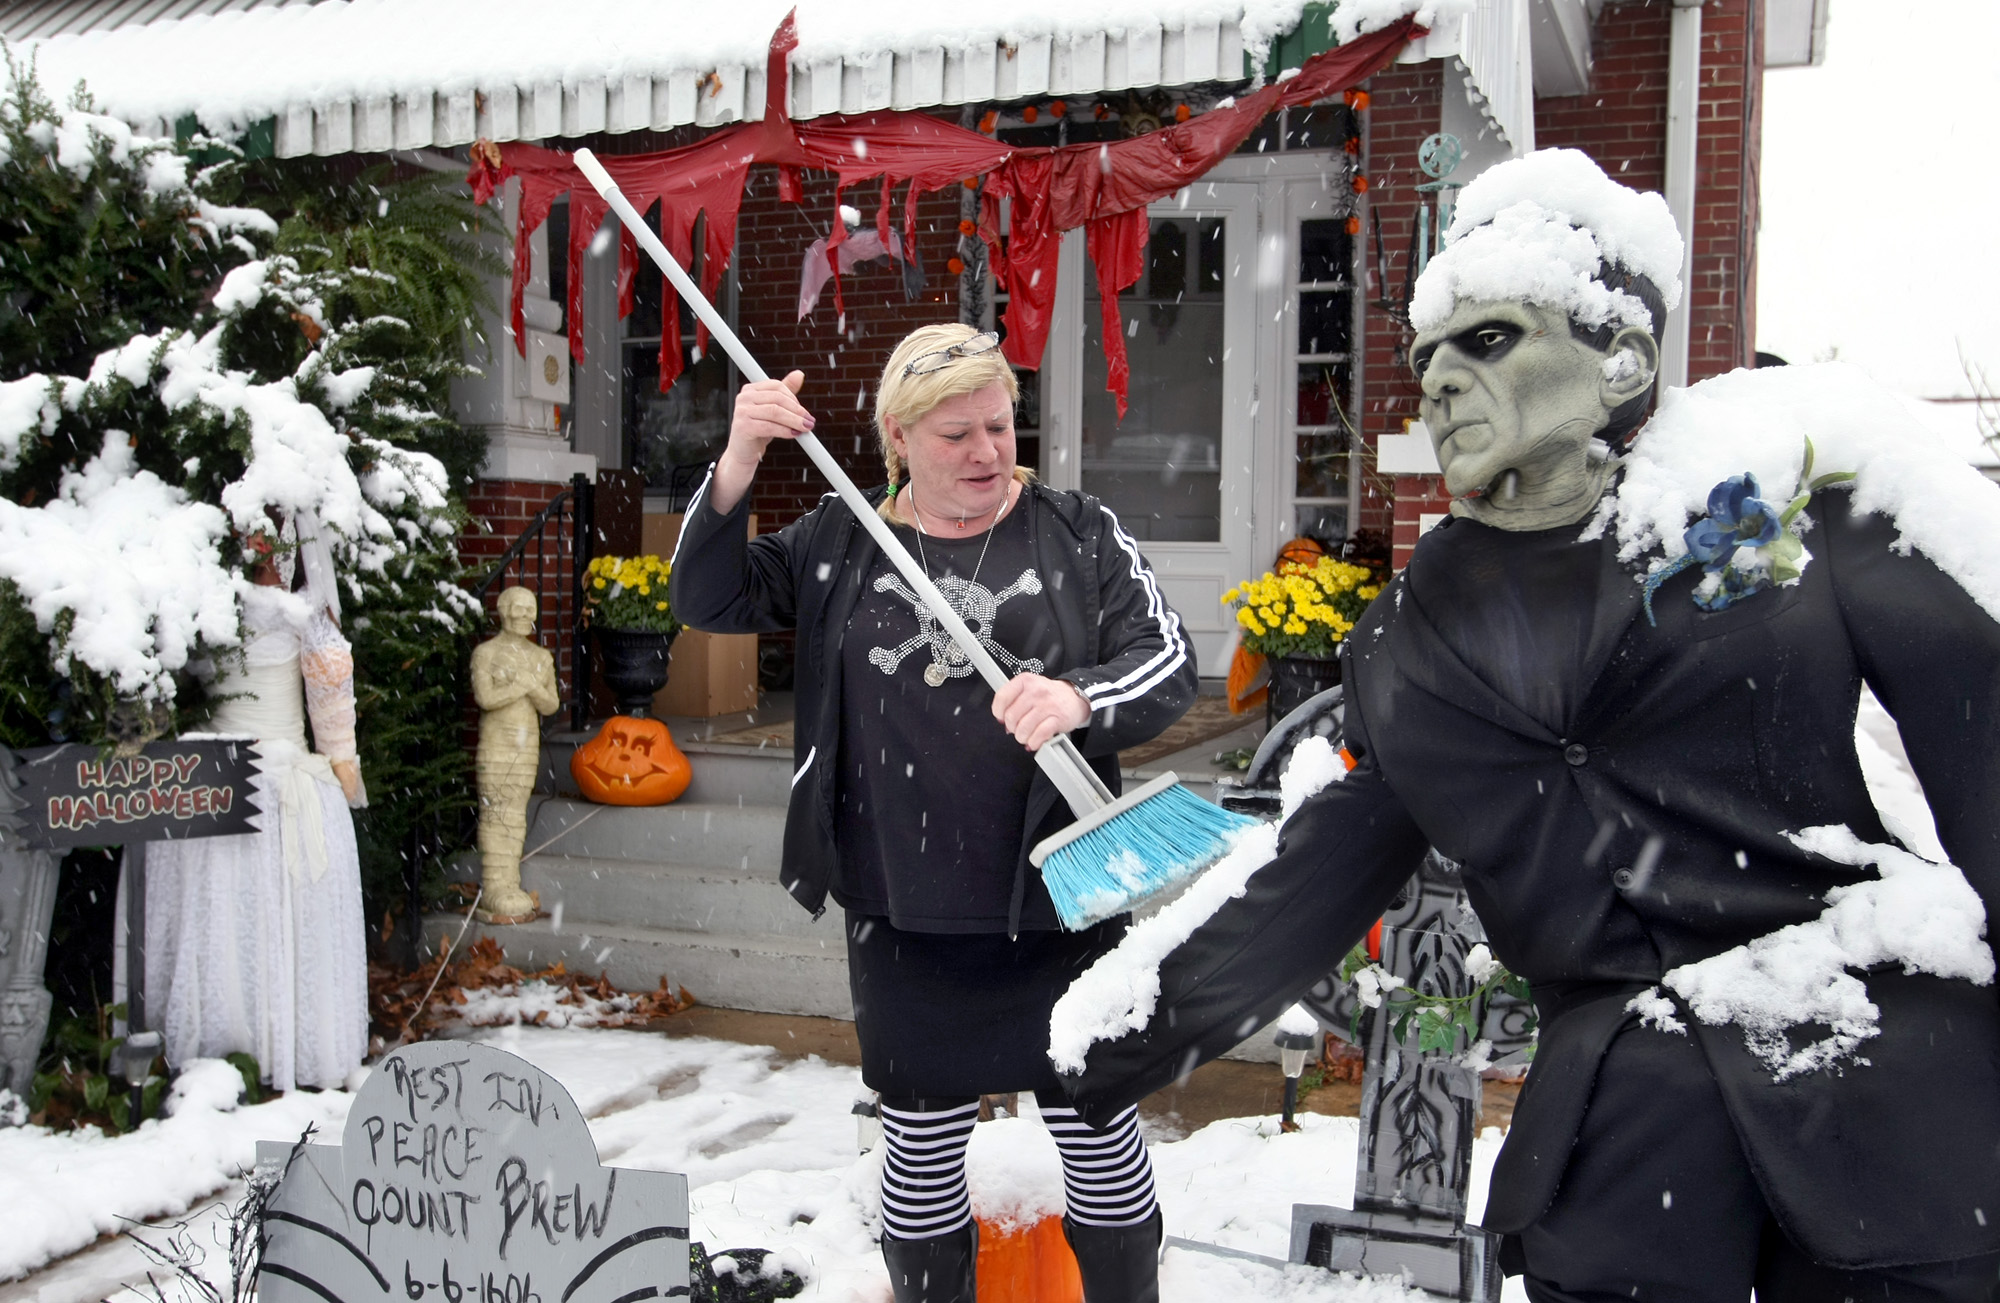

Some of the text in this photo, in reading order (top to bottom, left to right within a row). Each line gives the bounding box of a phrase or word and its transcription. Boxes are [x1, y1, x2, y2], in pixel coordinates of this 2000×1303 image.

[77, 753, 201, 790] HAPPY
[49, 785, 233, 831] HALLOWEEN
[384, 1055, 471, 1124] REST
[362, 1115, 488, 1185] PEACE
[495, 1155, 617, 1260] BREW
[404, 1257, 542, 1303] 6-6-1606
